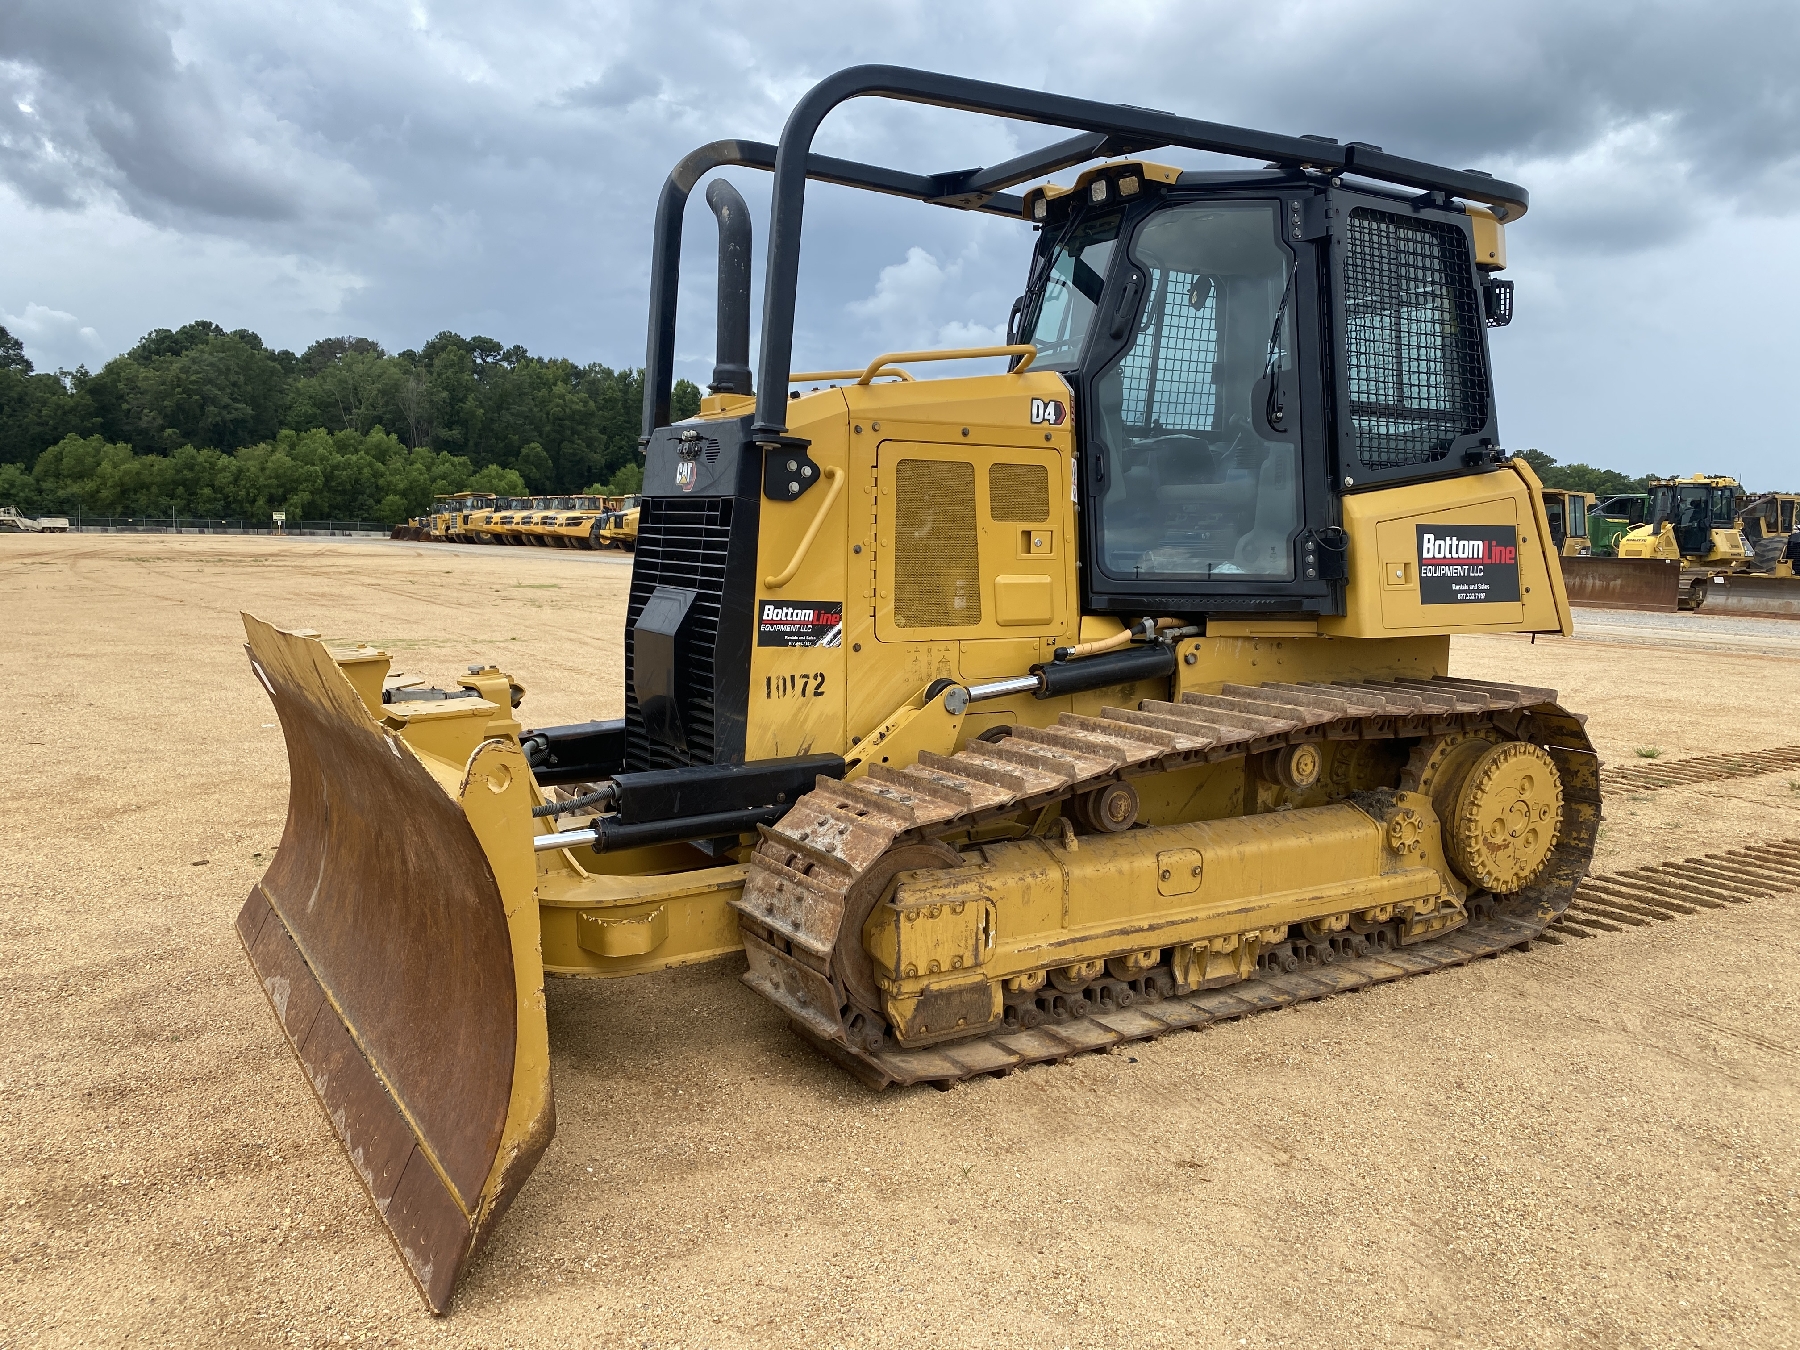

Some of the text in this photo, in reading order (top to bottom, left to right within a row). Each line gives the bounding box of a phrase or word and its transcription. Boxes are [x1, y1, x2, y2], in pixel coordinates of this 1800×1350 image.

[1031, 399, 1056, 424] D4
[676, 462, 693, 484] CAT
[1421, 565, 1484, 577] EQUIPMENT LLC
[760, 624, 813, 632] EQUIPMENT LLC
